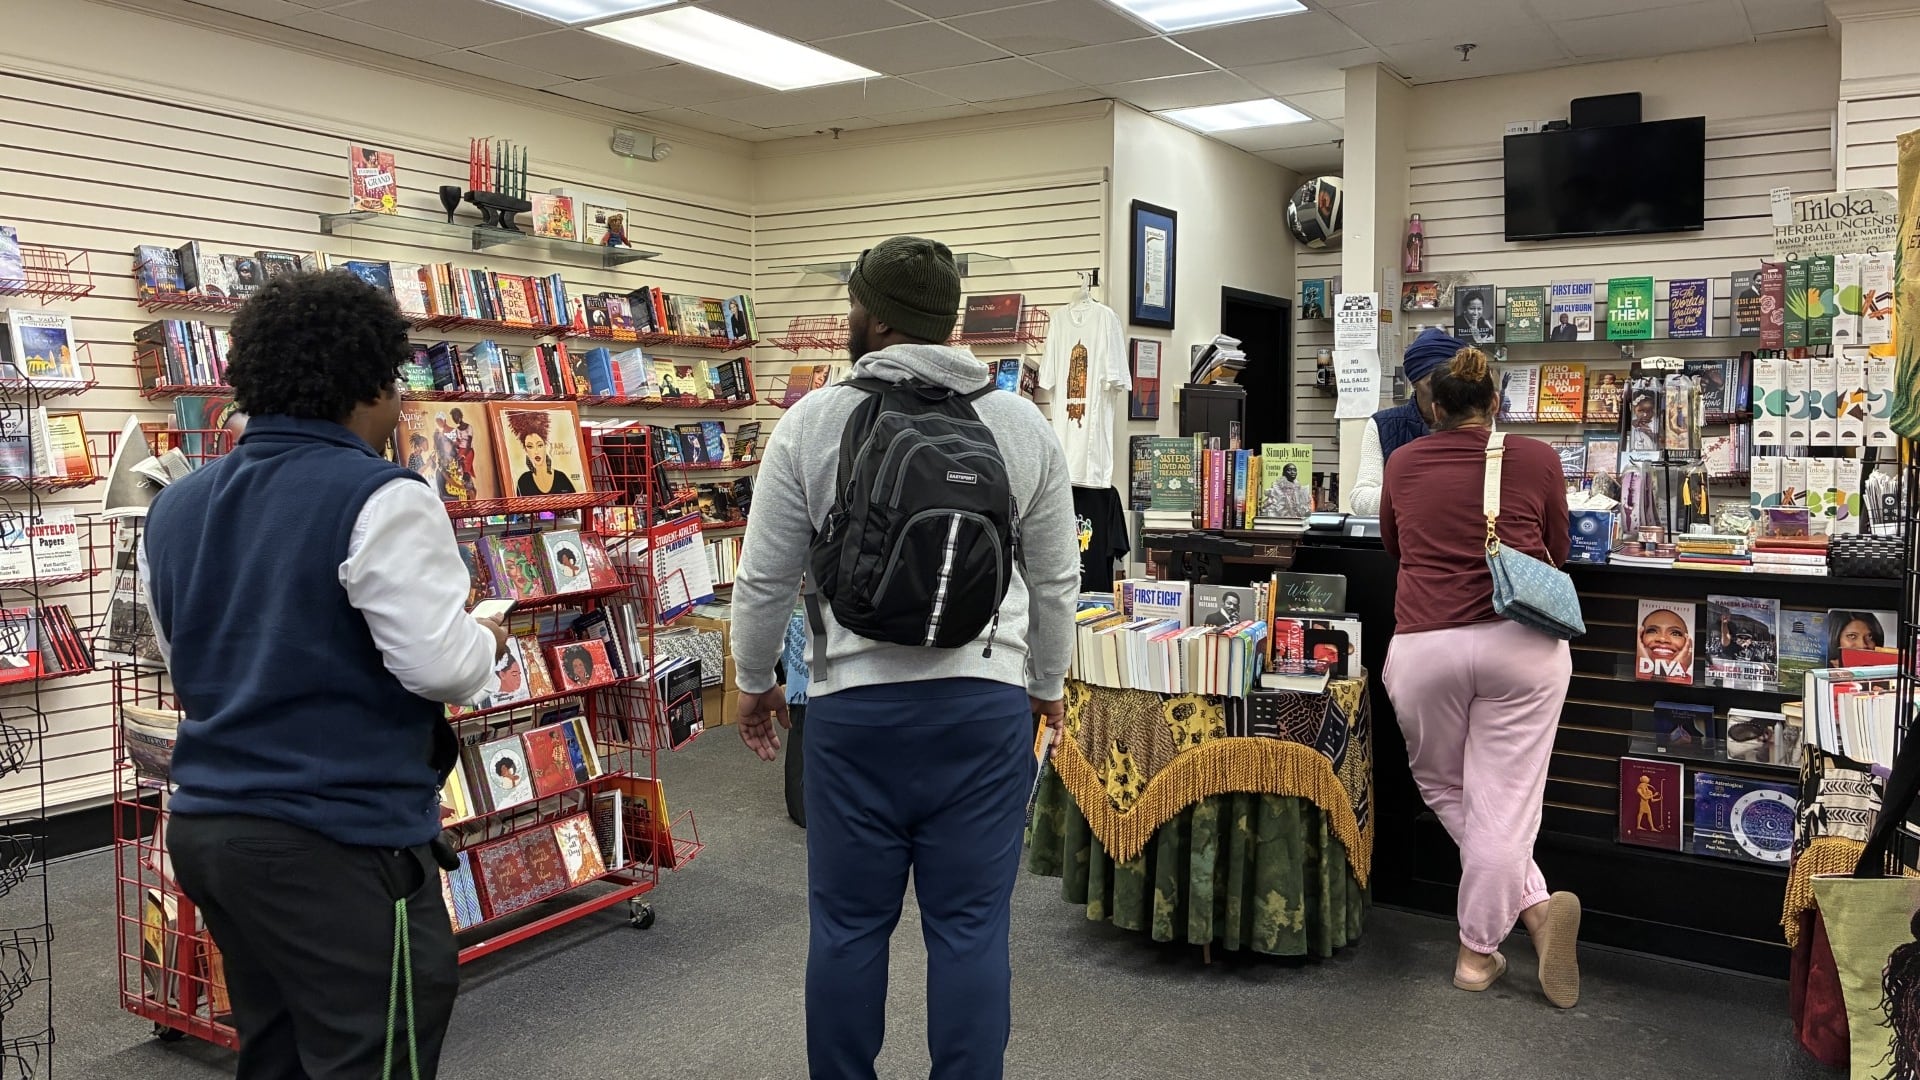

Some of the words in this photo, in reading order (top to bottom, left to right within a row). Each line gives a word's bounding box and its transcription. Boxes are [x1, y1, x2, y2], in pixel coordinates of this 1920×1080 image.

[1794, 195, 1875, 222] Triloka
[1775, 221, 1832, 238] HERBAL
[1836, 214, 1899, 231] INCENSE
[1775, 235, 1803, 246] HAND
[1803, 232, 1836, 245] ROLLED
[1842, 229, 1858, 239] ALL
[1860, 225, 1897, 237] NATURA
[502, 290, 522, 300] PIECE
[1552, 284, 1572, 296] FIRST
[1572, 283, 1593, 295] EIGHT
[1512, 300, 1538, 308] SISTERS
[1552, 304, 1564, 312] JIM
[1565, 304, 1592, 312] CLYBURN
[1616, 296, 1642, 308] LET
[1609, 309, 1648, 321] THEM
[1544, 365, 1569, 373] WHO
[1548, 372, 1581, 380] BETTER
[1544, 379, 1570, 387] THAN
[1555, 386, 1581, 394] YOU?
[399, 410, 422, 422] Annie
[1160, 454, 1190, 463] SISTERS
[1266, 448, 1289, 460] Simply
[1292, 448, 1310, 458] More
[25, 524, 75, 538] COINTELPRO
[655, 523, 698, 547] STUDENT-ATHLETE
[39, 538, 64, 548] Papers
[666, 535, 693, 554] PLAYBOOK
[1134, 588, 1156, 605] FIRST
[1157, 590, 1182, 606] EIGHT
[1286, 582, 1334, 604] Wedding
[1291, 622, 1300, 646] LOVE
